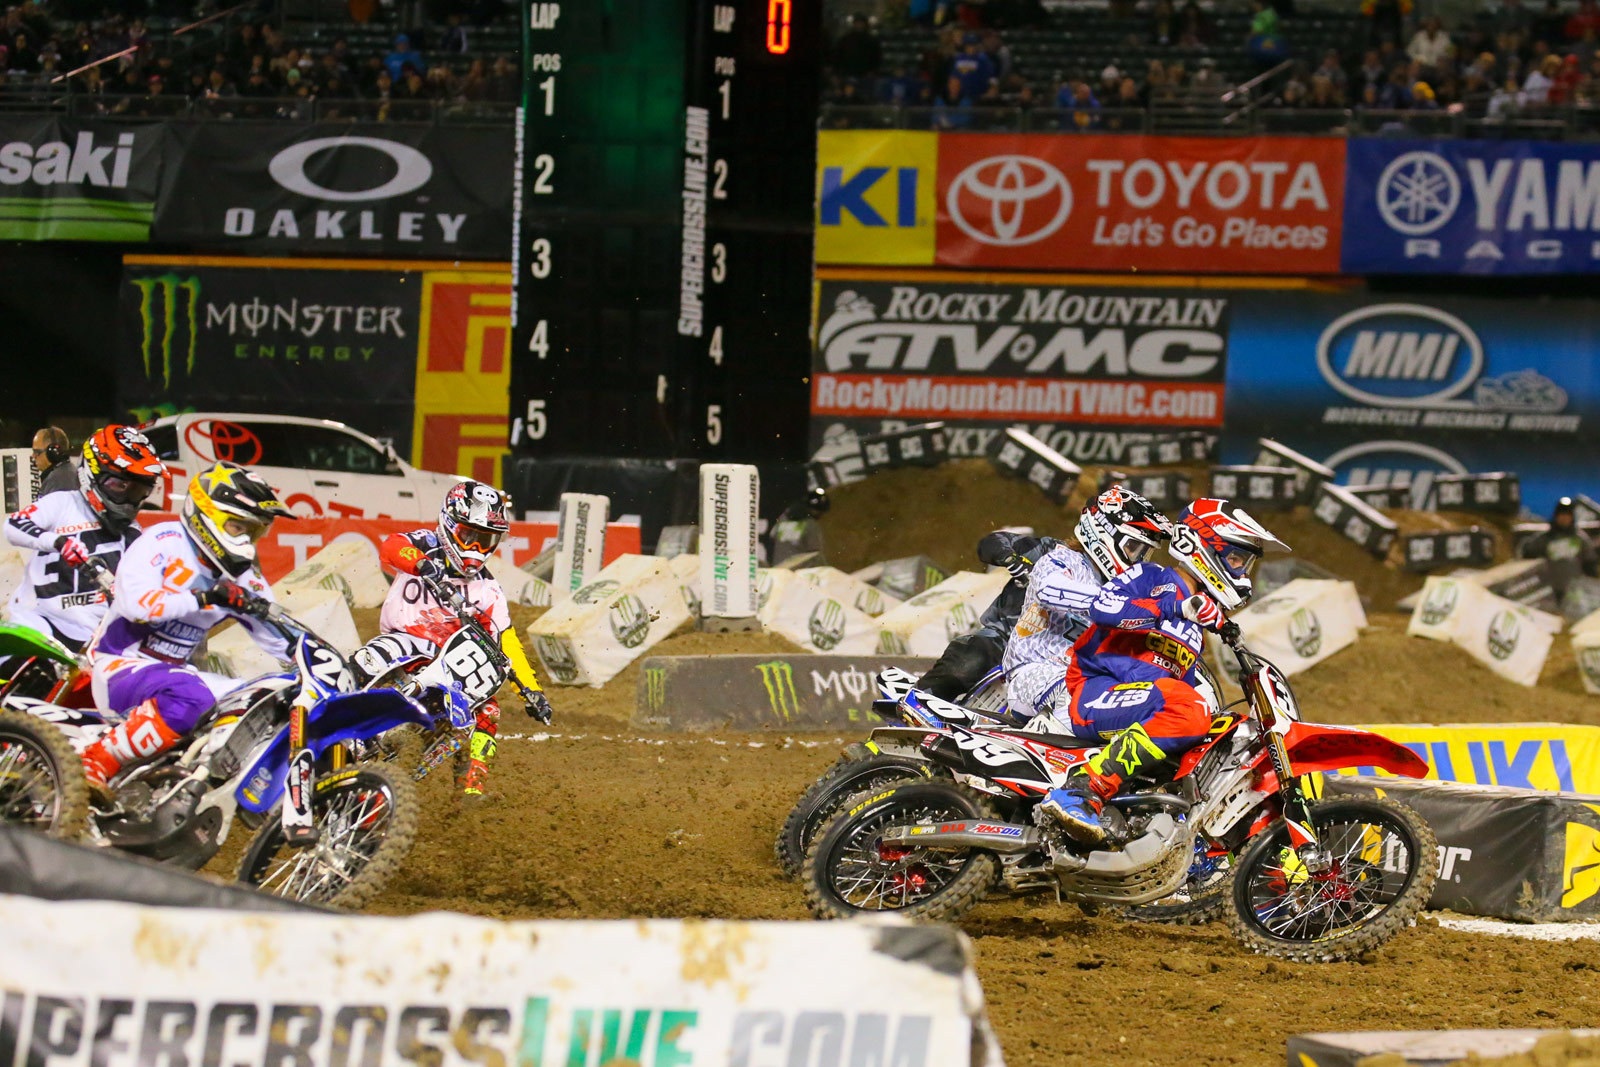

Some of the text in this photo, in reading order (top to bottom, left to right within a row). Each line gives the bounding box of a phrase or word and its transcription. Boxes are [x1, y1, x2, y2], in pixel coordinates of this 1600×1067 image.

[530, 2, 561, 30] LAP
[713, 4, 736, 33] LAP
[533, 53, 562, 73] POS
[714, 56, 736, 76] POS
[539, 76, 555, 117] 1
[718, 80, 732, 120] 1
[0, 131, 135, 188] saki
[534, 154, 555, 194] 2
[712, 159, 728, 200] 2
[1085, 157, 1330, 211] TOYOTA
[223, 207, 468, 243] OAKLEY
[1092, 216, 1328, 250] Let's Go Places
[531, 238, 552, 279] 3
[711, 243, 727, 284] 3
[882, 286, 1229, 327] ROCKY MOUNTAIN
[235, 344, 375, 362] ENERGY
[528, 320, 550, 359] 4
[708, 325, 724, 365] 4
[1343, 330, 1461, 381] MMI
[816, 376, 1217, 420] RockyMountainATVMC.com
[526, 399, 547, 440] 5
[706, 404, 722, 446] 5
[1093, 546, 1116, 576] BELL
[1191, 556, 1226, 592] GEICO
[444, 639, 502, 698] 65
[1145, 632, 1197, 671] GEICO
[849, 790, 897, 817] DUNLOP
[975, 823, 1022, 837] AMSOIL
